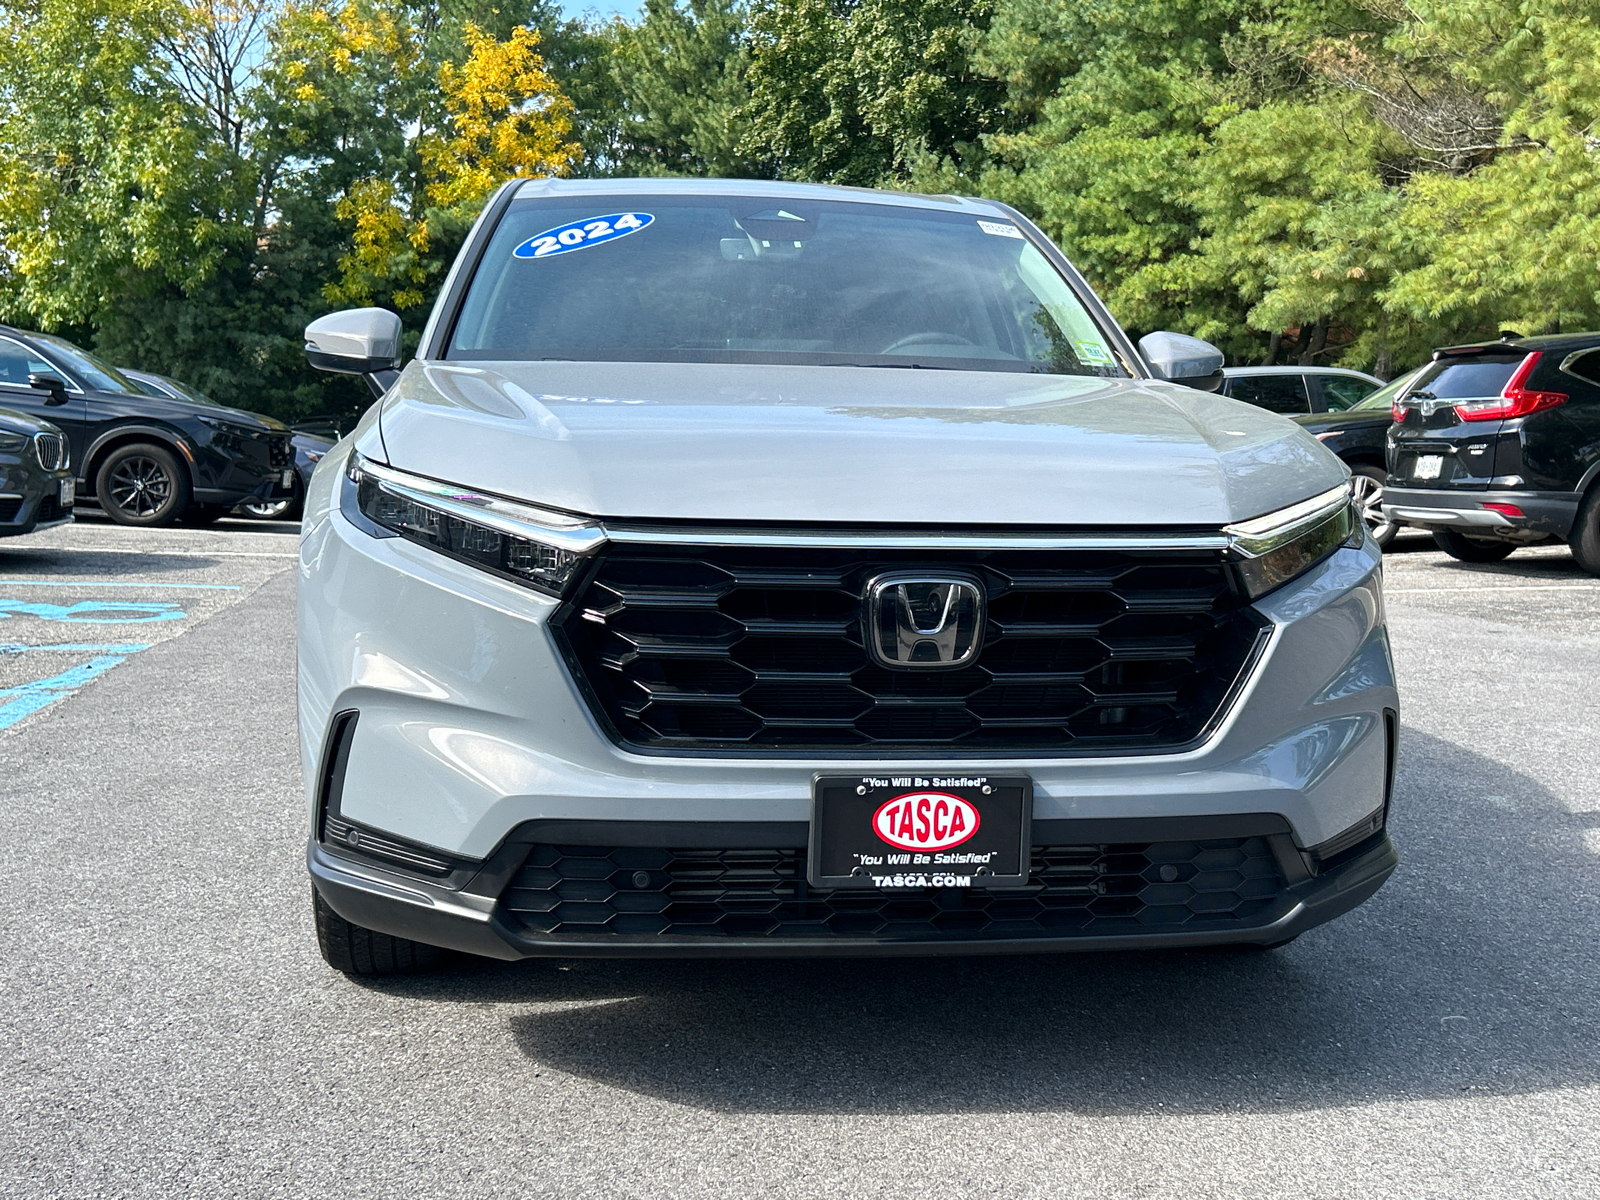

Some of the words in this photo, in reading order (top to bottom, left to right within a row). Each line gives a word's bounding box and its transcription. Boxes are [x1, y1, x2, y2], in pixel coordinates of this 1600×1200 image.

[530, 213, 643, 256] 2024
[891, 777, 911, 787] Will
[914, 777, 930, 787] Be
[885, 798, 966, 843] TASCA
[887, 853, 910, 865] Will
[913, 853, 931, 864] Be
[872, 876, 971, 887] TASCA.COM
